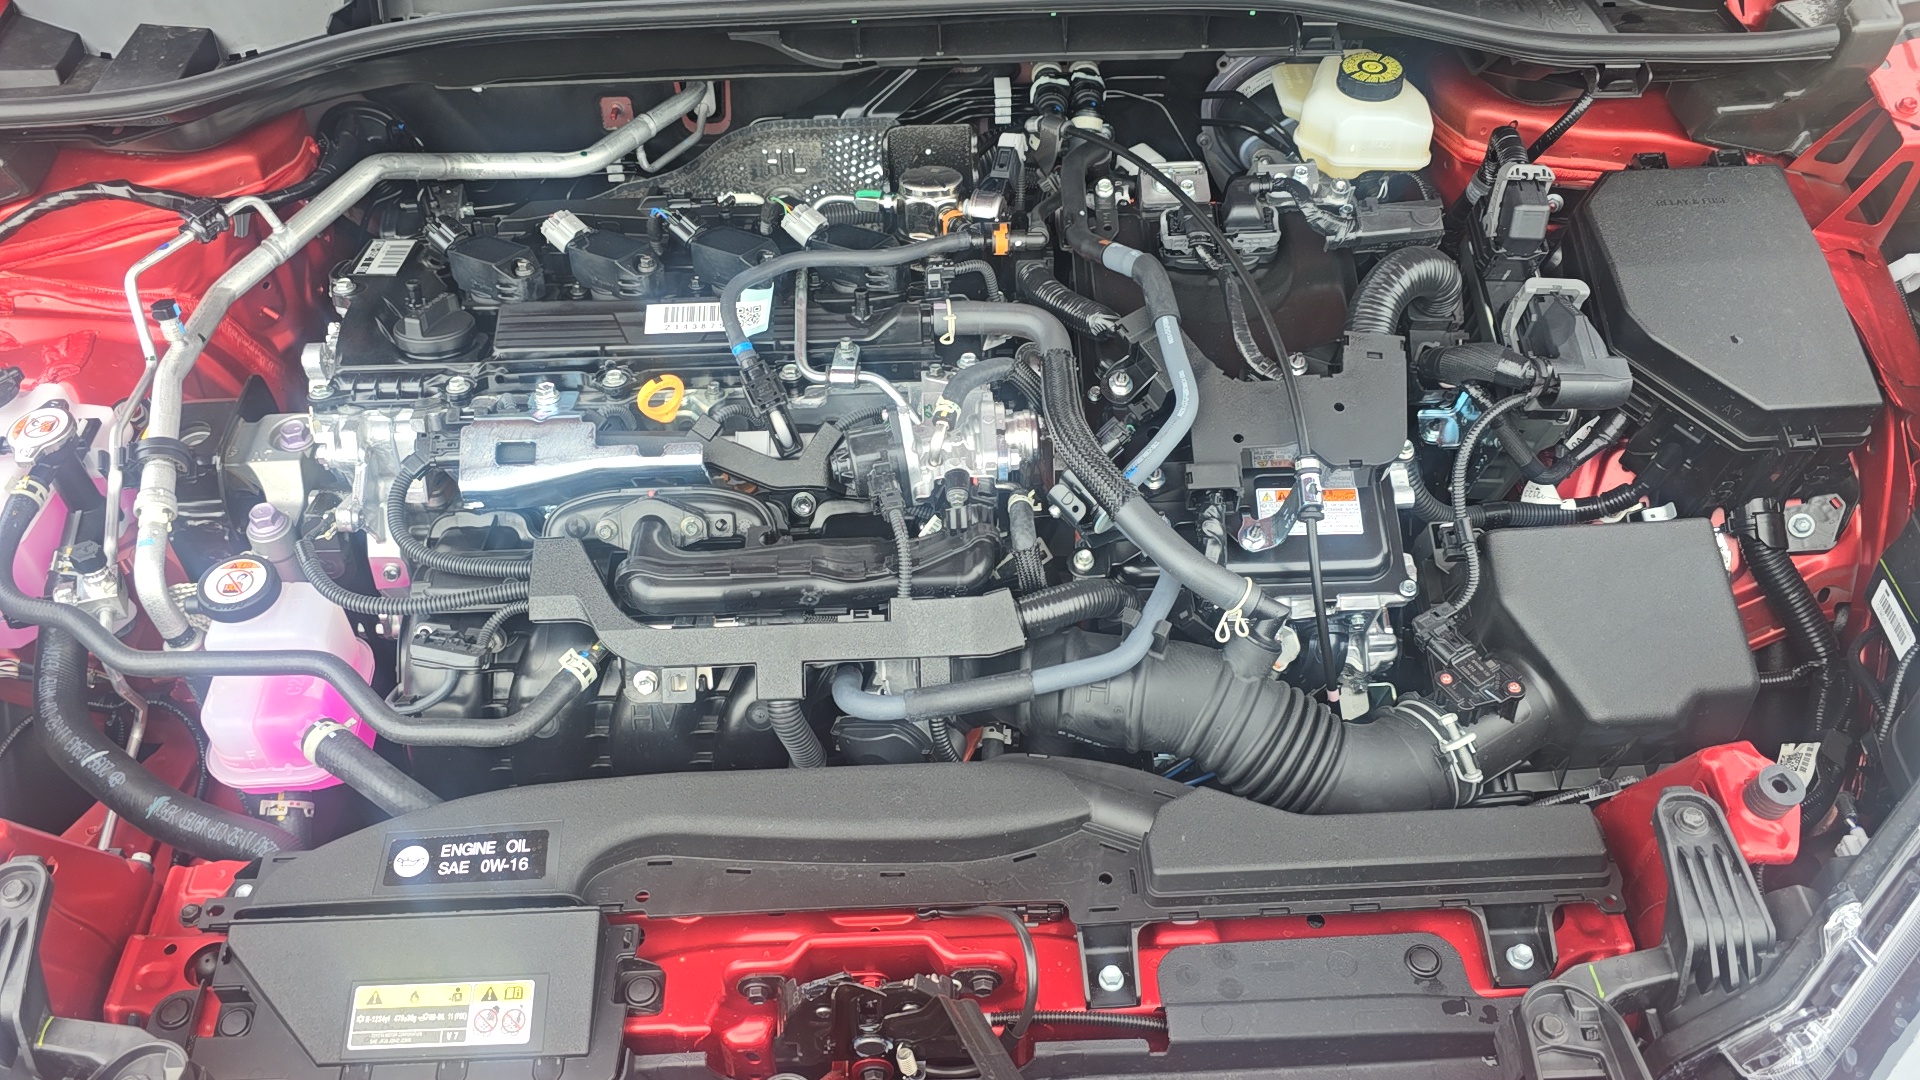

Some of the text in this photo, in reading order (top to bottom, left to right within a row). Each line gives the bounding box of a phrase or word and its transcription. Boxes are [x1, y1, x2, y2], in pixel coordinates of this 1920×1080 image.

[631, 704, 678, 731] HV
[178, 810, 212, 834] WATER
[440, 839, 531, 857] ENGINE OIL
[437, 857, 529, 875] SAE 0W-16
